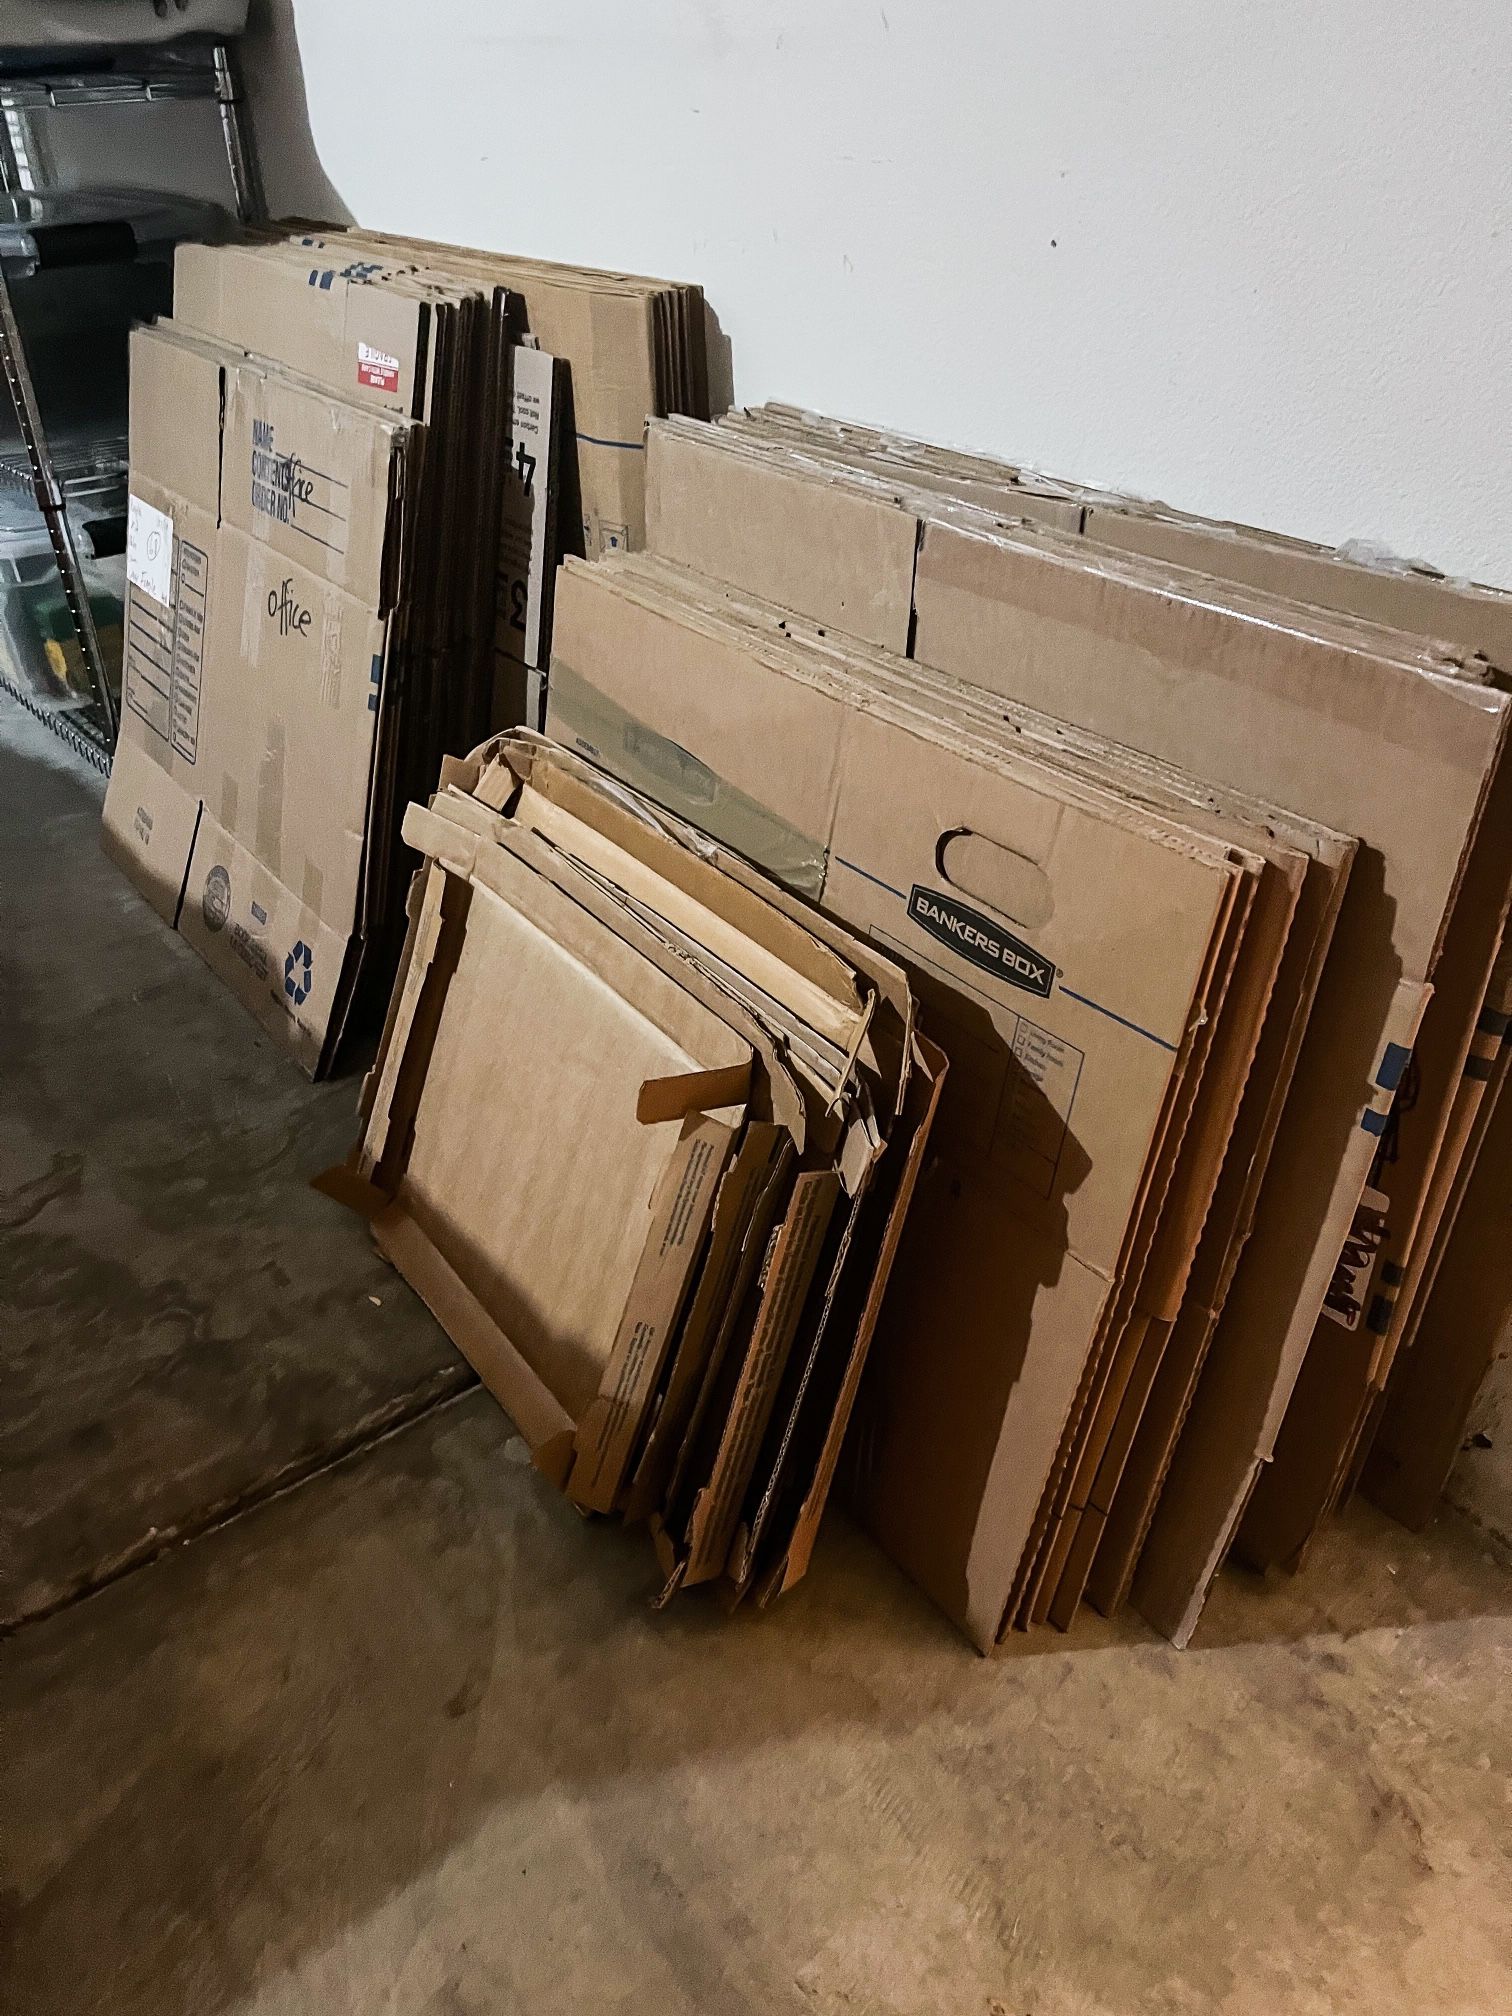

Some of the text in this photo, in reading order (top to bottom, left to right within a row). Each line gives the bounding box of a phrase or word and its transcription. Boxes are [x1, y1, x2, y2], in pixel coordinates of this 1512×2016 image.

[268, 578, 312, 638] office
[915, 896, 1046, 986] BANKERS BOX
